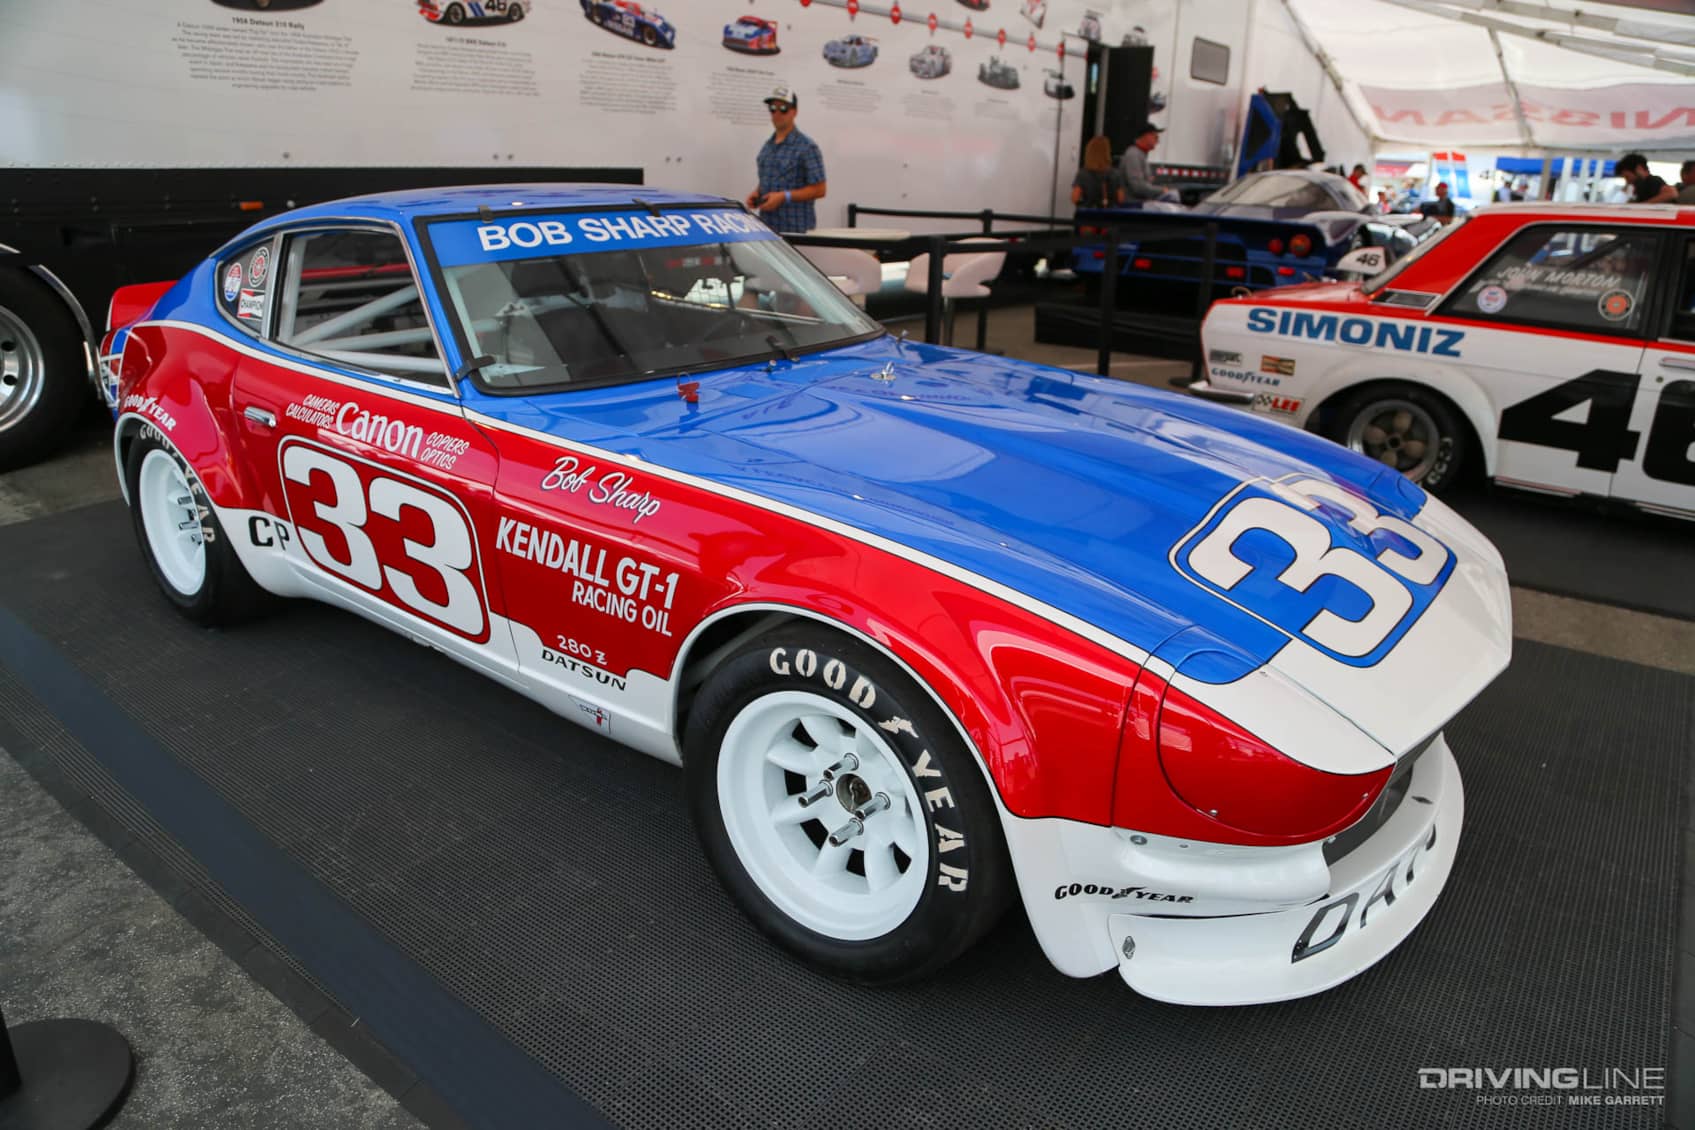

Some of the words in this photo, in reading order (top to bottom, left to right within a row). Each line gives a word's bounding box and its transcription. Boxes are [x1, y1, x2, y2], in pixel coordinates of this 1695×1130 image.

[477, 221, 573, 251] BOB
[577, 213, 691, 242] SHARP
[1356, 253, 1381, 267] 46
[1497, 266, 1542, 282] JOHN
[1545, 271, 1621, 289] MORTON
[1247, 308, 1465, 358] SIMONIZ
[1211, 367, 1281, 387] GOODYEAR
[123, 394, 177, 432] GOODYEAR
[285, 403, 334, 429] CALCULATORS
[303, 394, 341, 415] CAMERAS
[1272, 397, 1301, 412] LEE
[336, 402, 424, 458] Canon
[426, 432, 470, 456] COPIERS
[420, 448, 457, 470] OPTICS
[541, 456, 596, 493] Bob
[588, 472, 661, 524] Sharp
[284, 446, 484, 636] 33
[496, 516, 609, 586] KENDALL
[616, 557, 680, 610] GT-1
[1188, 479, 1449, 657] 33
[572, 581, 638, 623] RACING
[642, 605, 673, 637] OIL
[556, 634, 592, 658] 280
[541, 649, 627, 691] DATSUN
[1054, 882, 1195, 904] GOODYEAR
